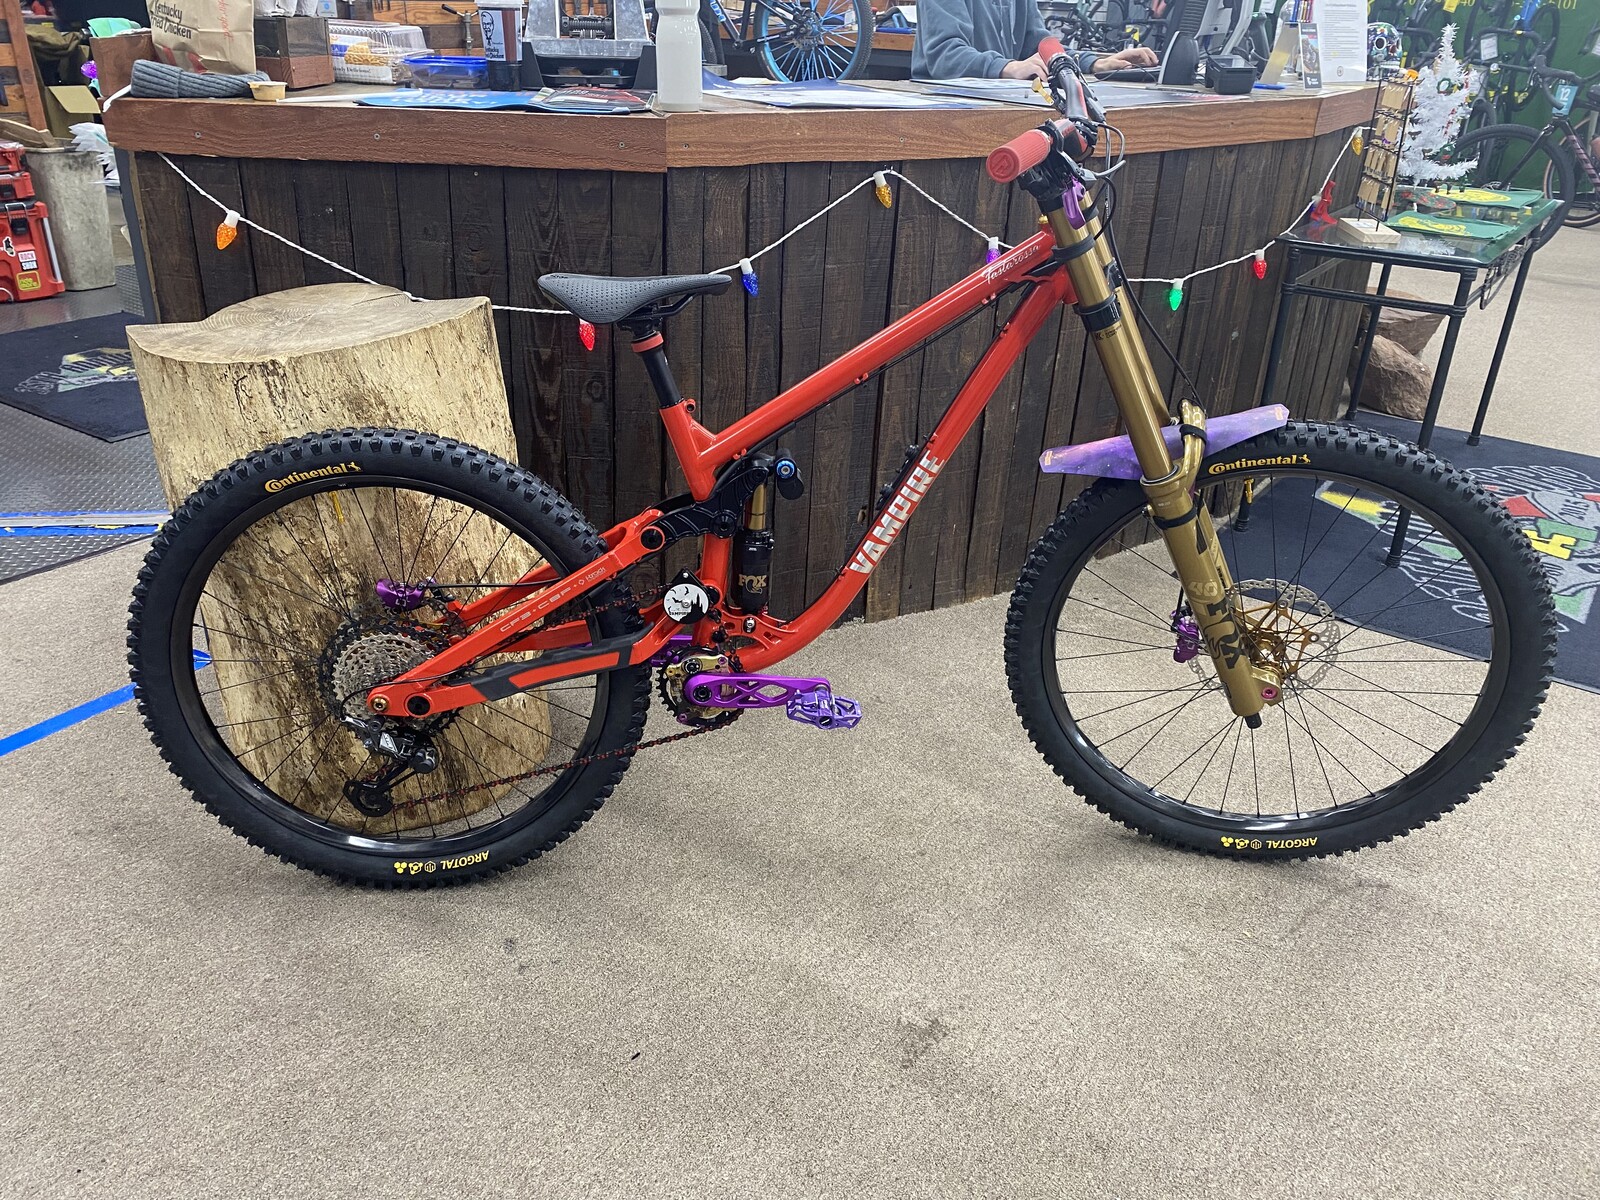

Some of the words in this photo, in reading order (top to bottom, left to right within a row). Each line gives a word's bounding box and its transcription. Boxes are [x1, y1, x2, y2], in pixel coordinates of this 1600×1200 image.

[154, 0, 183, 23] Kentucky
[1208, 454, 1297, 475] Continental
[264, 463, 348, 493] Continental
[849, 449, 945, 574] VAMPIRE
[738, 574, 767, 592] FOX
[1203, 600, 1248, 670] FOX
[1266, 837, 1318, 849] ARGOTAL
[440, 850, 490, 870] ARGOTAL
